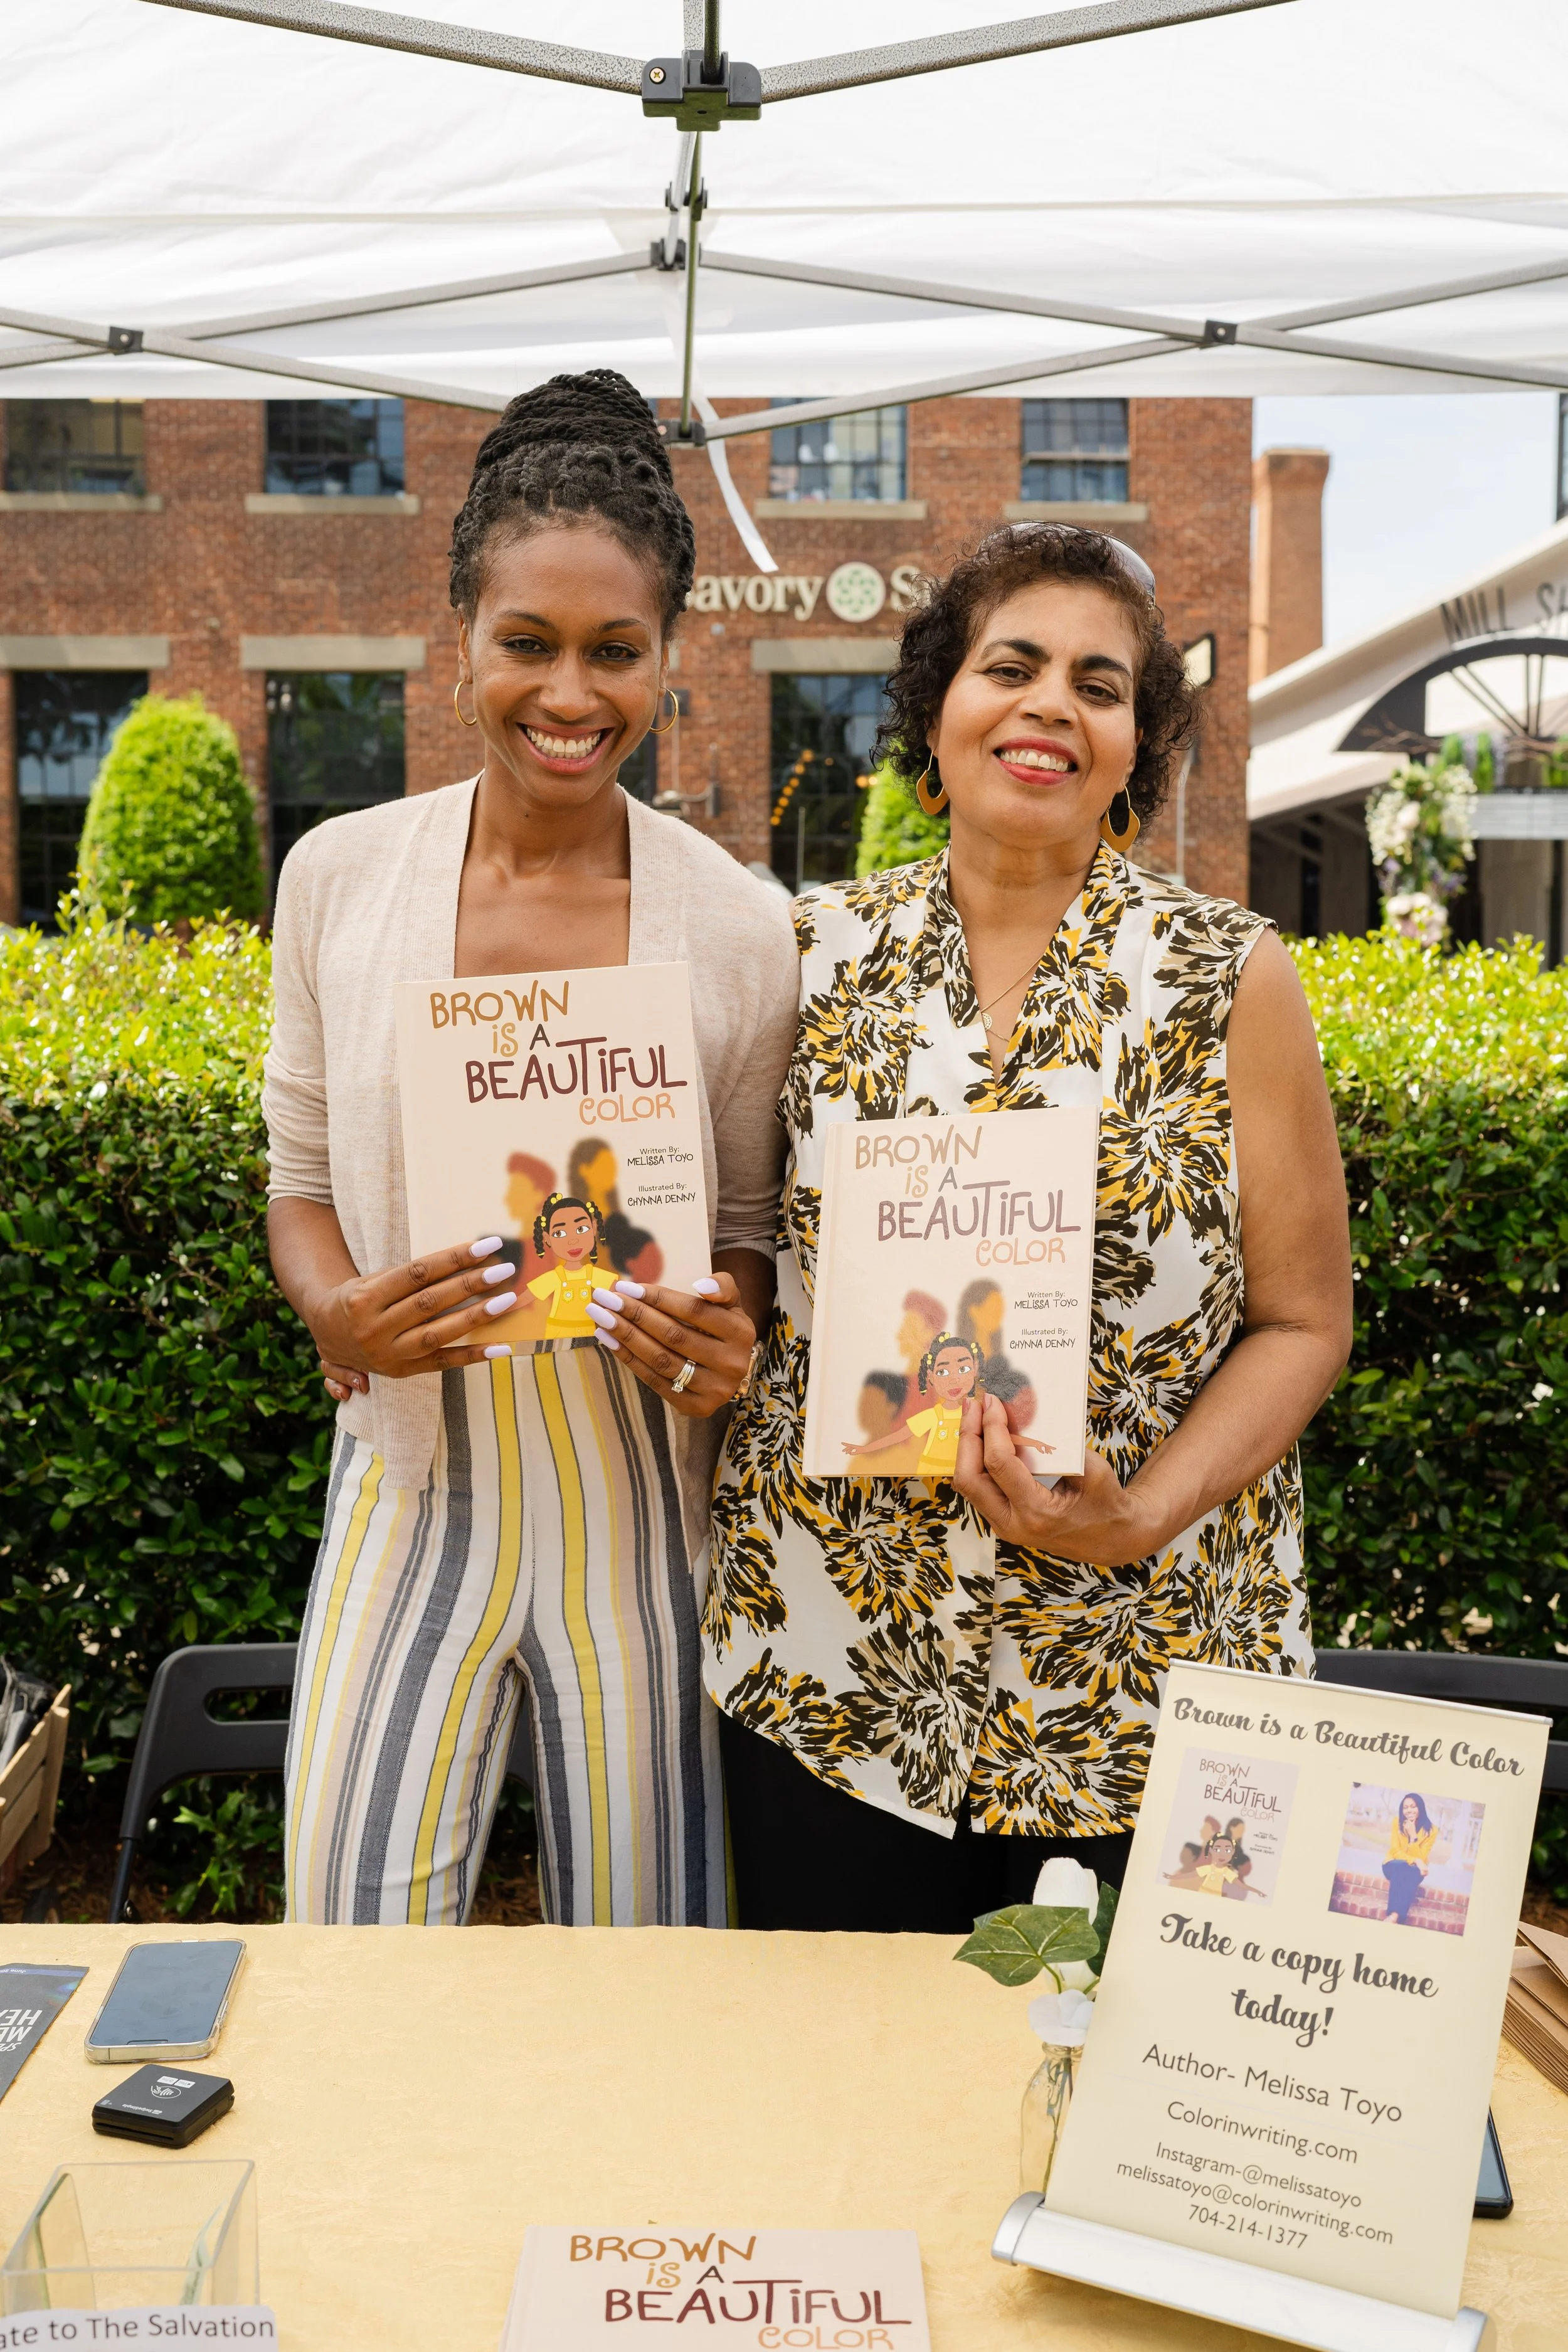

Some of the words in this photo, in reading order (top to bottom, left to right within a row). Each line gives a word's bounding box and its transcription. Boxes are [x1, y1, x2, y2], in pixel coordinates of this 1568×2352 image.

[686, 574, 823, 622] avory
[430, 980, 569, 1029] BROWN
[529, 1024, 550, 1050] A
[579, 1093, 675, 1125] COLOR
[667, 1153, 694, 1163] TOYO
[856, 1124, 982, 1170] BROWN
[638, 1183, 674, 1192] Illustrated
[938, 1167, 957, 1192] A
[628, 1195, 662, 1206] CHYNNA
[665, 1192, 696, 1203] DENNY
[976, 1237, 1066, 1266] COLOR
[1053, 1298, 1078, 1308] TOYO
[1010, 1339, 1042, 1349] CHYNNA
[1046, 1338, 1076, 1348] DENNY
[1173, 1697, 1254, 1731] Brown
[1260, 1713, 1281, 1735] is
[1290, 1724, 1308, 1740] a
[1314, 1720, 1443, 1764] Beautiful
[1450, 1742, 1525, 1776] Color
[1199, 1759, 1251, 1778] BROWN
[1230, 1778, 1237, 1786] A
[1241, 1807, 1274, 1822] COLOR
[1160, 1913, 1236, 1956] Take
[1242, 1942, 1265, 1962] a
[1271, 1947, 1345, 1994] copy
[1353, 1953, 1439, 1998] home
[1231, 1989, 1334, 2048] today!
[1142, 2043, 1235, 2080] Author-
[1244, 2066, 1329, 2106] Melissa
[1340, 2087, 1402, 2124] Toyo
[1168, 2101, 1358, 2163] Colorinwriting.com
[1156, 2142, 1362, 2209] Instagram-@melissatoyo
[1117, 2163, 1393, 2244] melissatoyo@colorinwriting.com
[1189, 2205, 1308, 2249] 704-214-1377
[569, 2233, 756, 2264] BROWN
[696, 2265, 724, 2284] A
[49, 2321, 77, 2340] to
[86, 2317, 138, 2338] The
[149, 2313, 274, 2338] Salvation
[758, 2326, 894, 2351] COLOR
